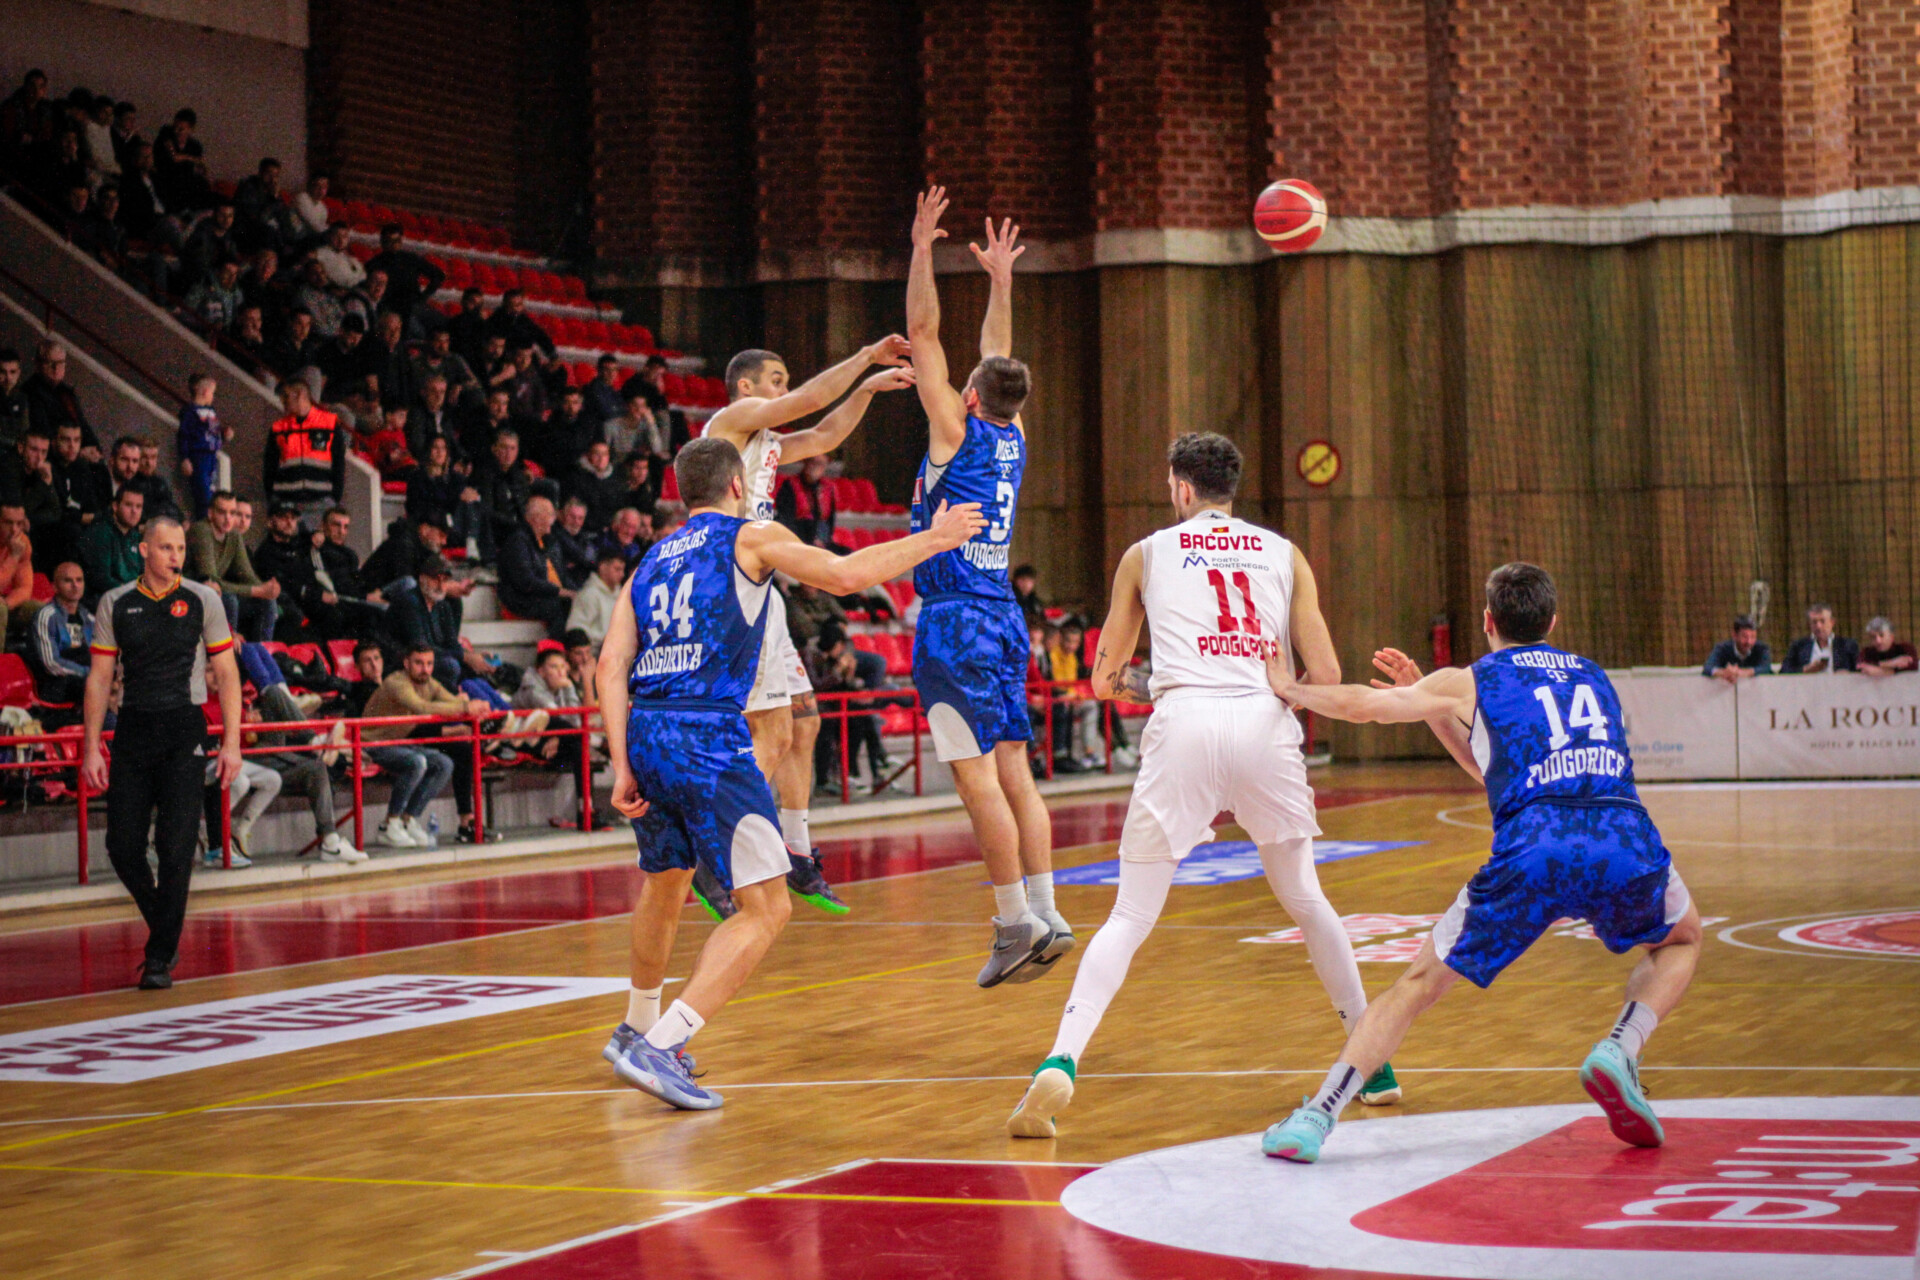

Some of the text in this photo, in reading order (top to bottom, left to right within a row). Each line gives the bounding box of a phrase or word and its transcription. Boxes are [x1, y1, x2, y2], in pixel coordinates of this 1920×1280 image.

[990, 481, 1014, 542] 3
[1212, 563, 1270, 571] MONTENEGRO
[647, 572, 695, 646] 34
[1207, 568, 1261, 636] 11
[631, 643, 703, 678] ODGORICA
[1533, 684, 1608, 751] 14
[1770, 708, 1812, 729] LA
